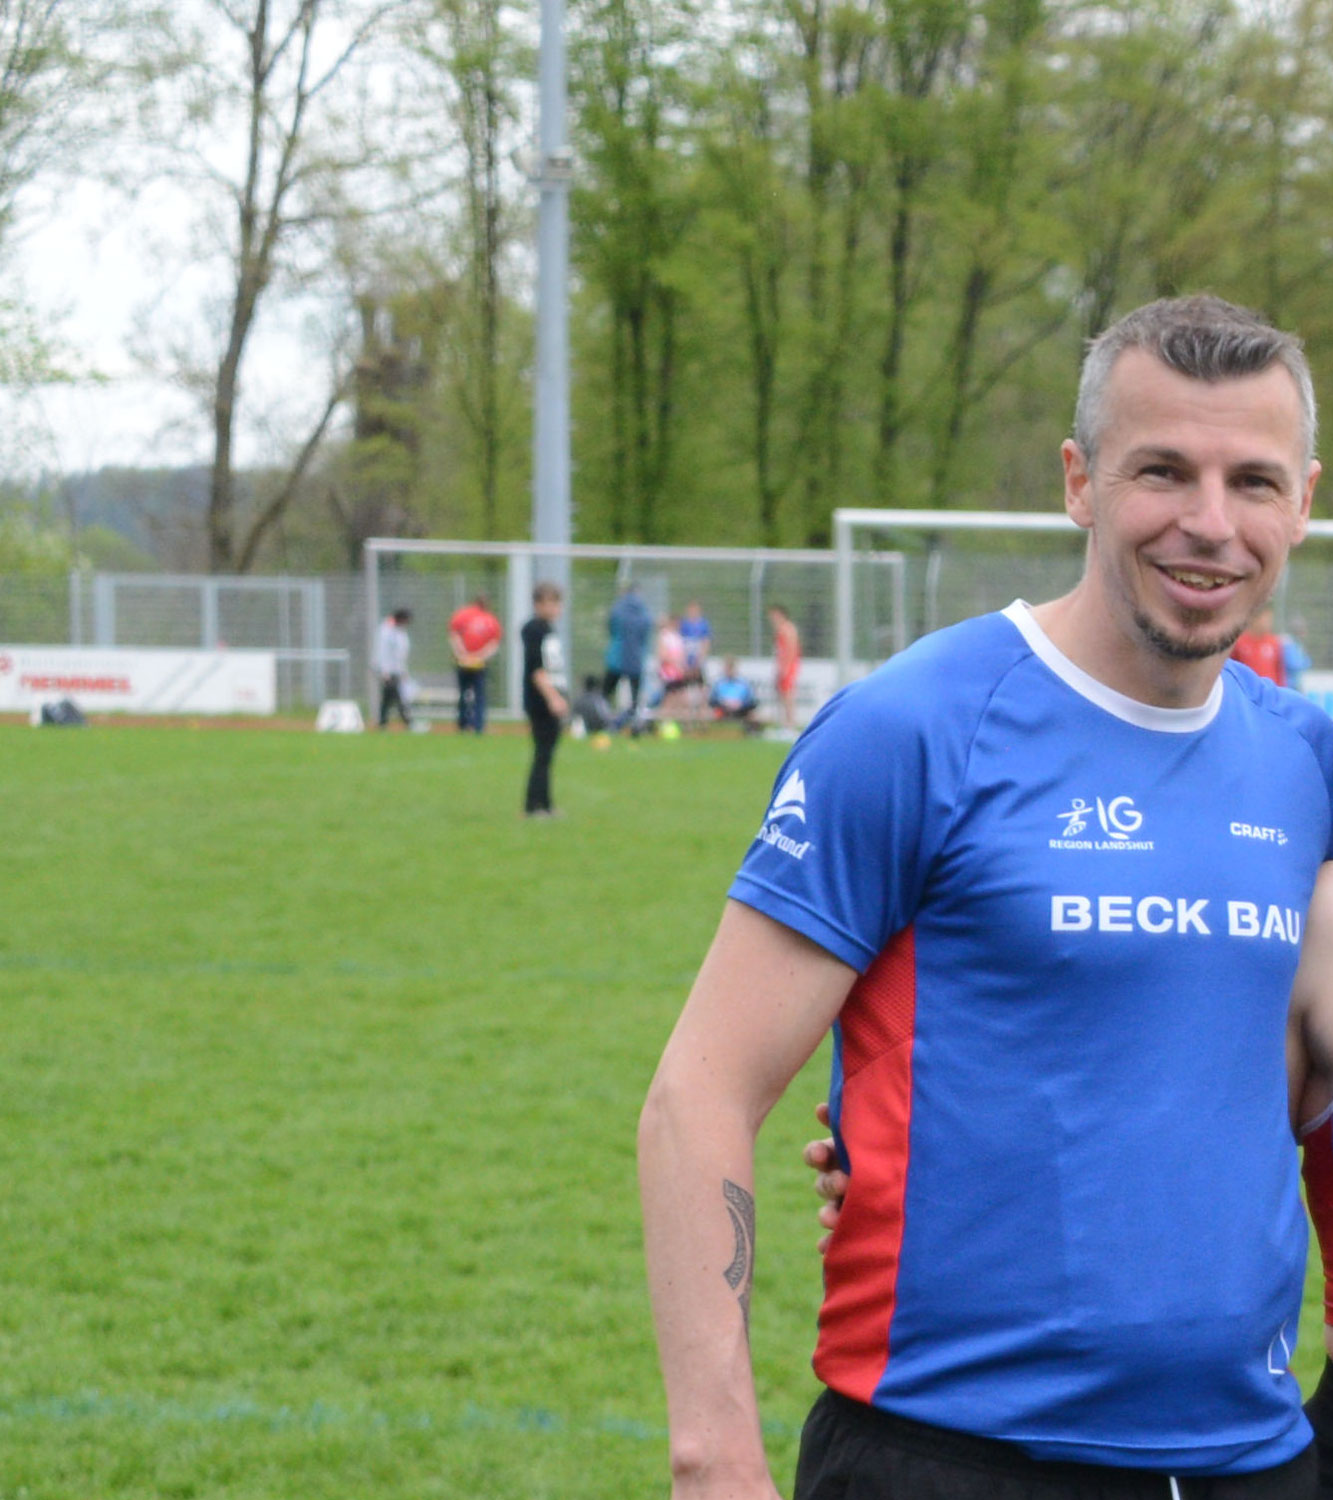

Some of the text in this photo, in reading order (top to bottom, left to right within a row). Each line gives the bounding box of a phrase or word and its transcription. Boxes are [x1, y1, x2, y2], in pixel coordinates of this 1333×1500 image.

[1230, 822, 1276, 842] CRAFT
[1049, 839, 1154, 851] REGION LANDSHUT
[1051, 896, 1300, 945] BECK BAU
